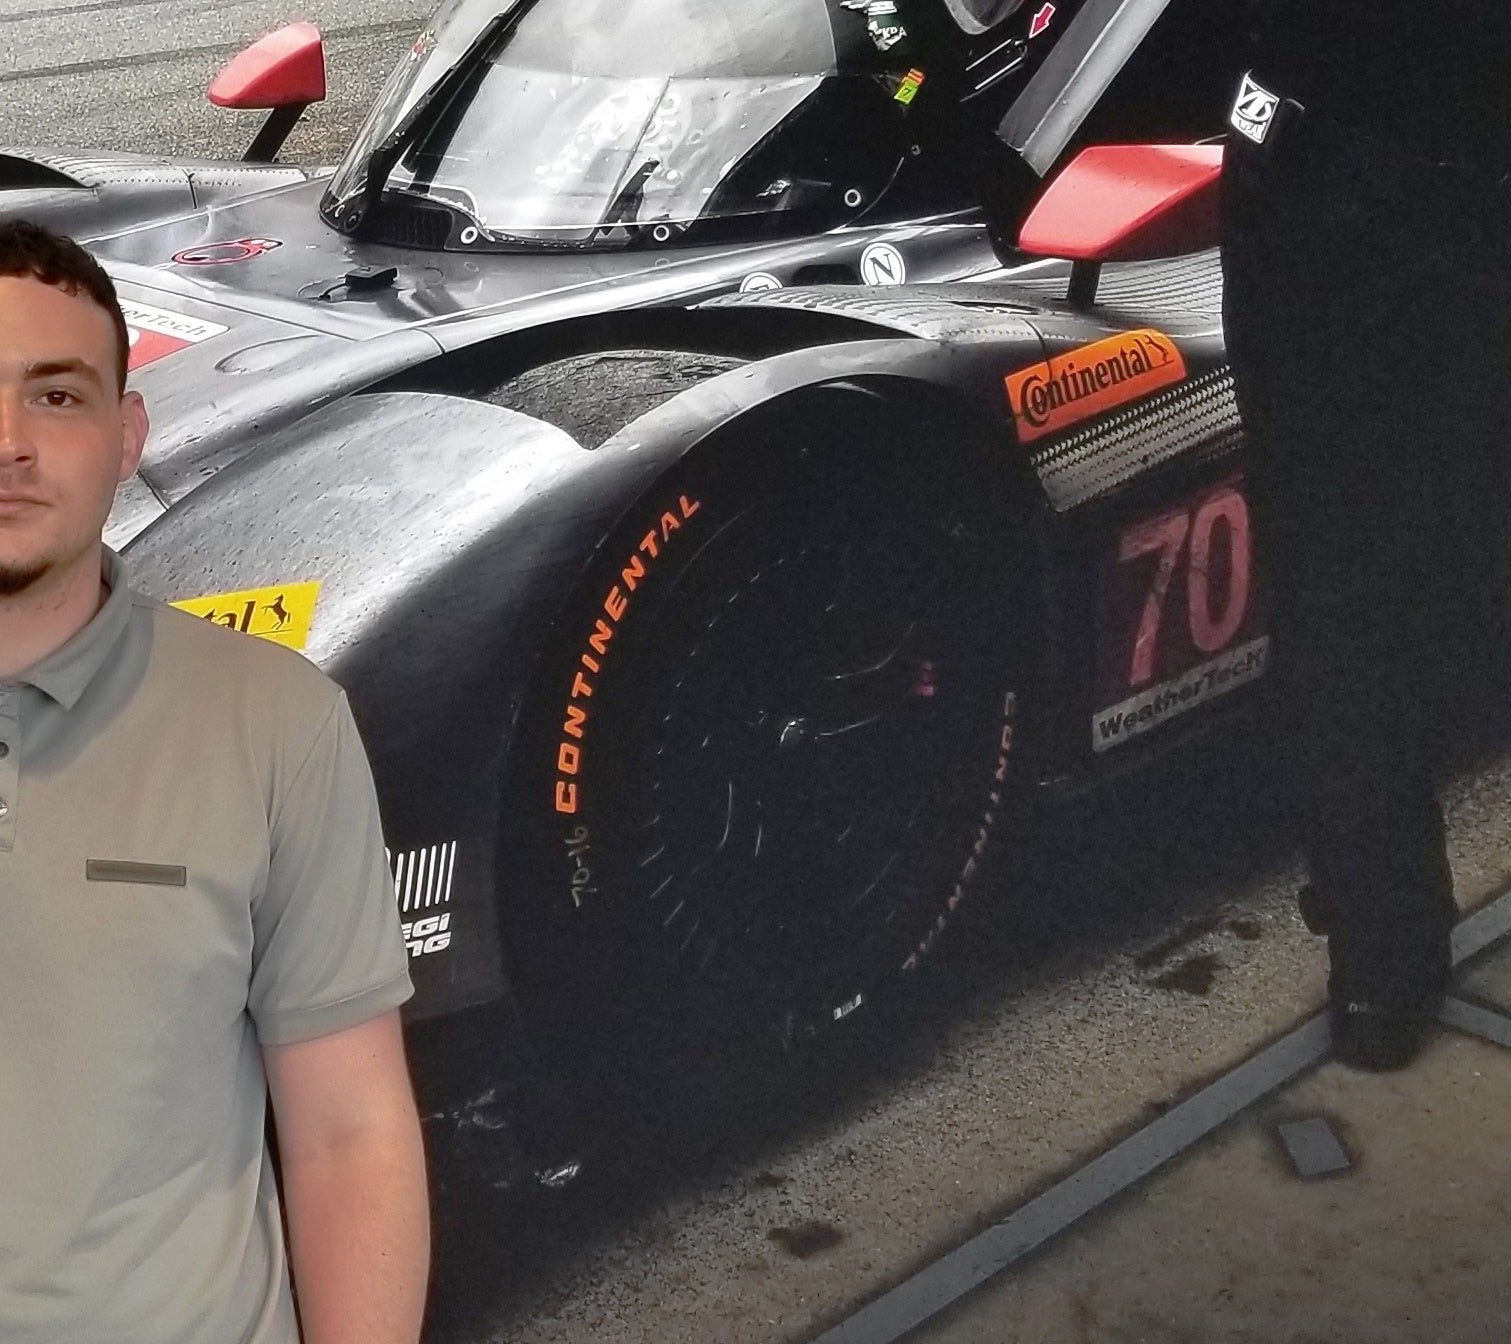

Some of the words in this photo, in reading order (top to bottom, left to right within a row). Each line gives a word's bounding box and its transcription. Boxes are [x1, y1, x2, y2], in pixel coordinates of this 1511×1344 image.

[1019, 348, 1153, 428] Continental
[555, 494, 700, 814] CONTINENTAL
[1117, 488, 1251, 686] 70
[1098, 647, 1266, 742] WeatherTech
